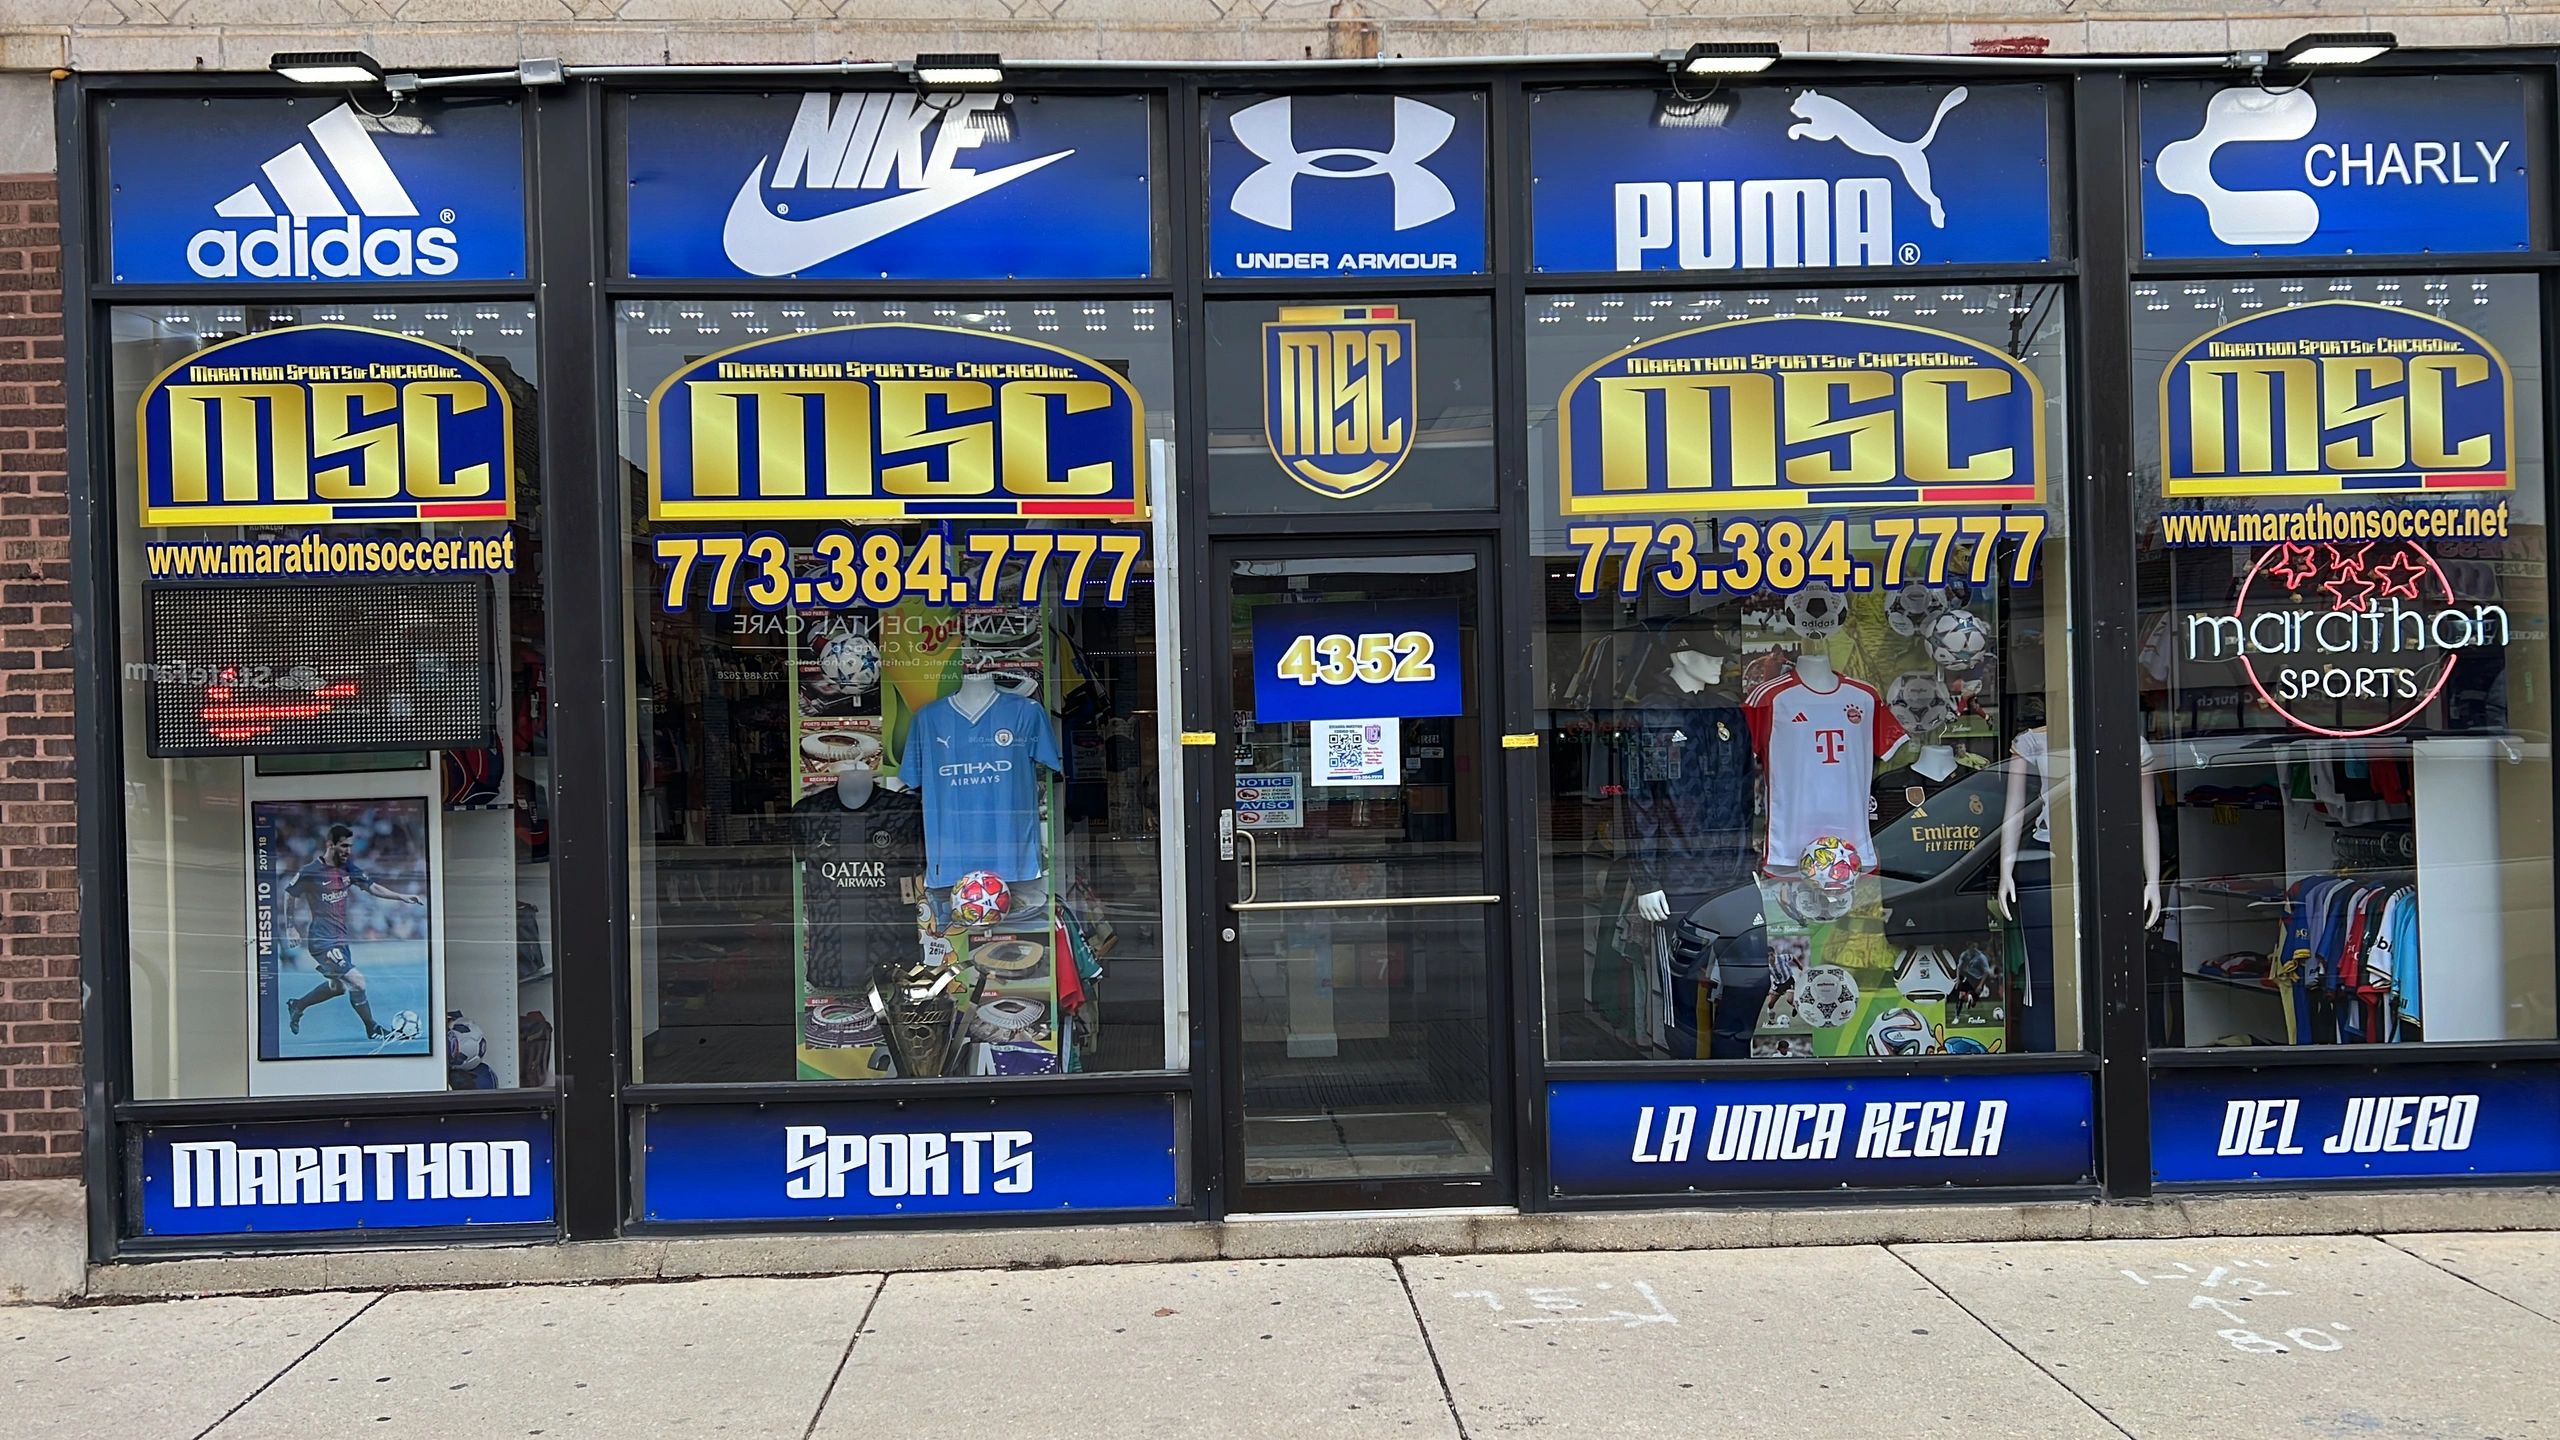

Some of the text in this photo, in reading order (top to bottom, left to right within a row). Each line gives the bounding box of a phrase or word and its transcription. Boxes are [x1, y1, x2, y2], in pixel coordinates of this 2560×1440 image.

[770, 92, 1000, 190] NIKE
[2304, 141, 2511, 188] CHARLY
[186, 215, 459, 278] adidas
[1615, 177, 1894, 272] PUMA
[1236, 252, 1457, 270] UNDER ARMOUR
[718, 361, 843, 379] MARATHON
[846, 360, 935, 378] SPORTS
[956, 361, 1049, 378] CHICAGO
[1627, 356, 1747, 374] MARATHON
[1751, 353, 1839, 370] SPORTS
[1858, 352, 1949, 368] CHICAGO
[2208, 341, 2297, 358] MARATHON
[2299, 338, 2362, 355] SPORTS
[2377, 337, 2444, 353] CHICAGO
[189, 365, 284, 382] MARATHON
[287, 363, 352, 380] SPORTS
[369, 362, 439, 380] CHICAGO
[1278, 329, 1402, 456] MSC
[1594, 368, 2014, 492] MSC
[2185, 353, 2492, 474] MSC
[164, 381, 490, 502] MSC
[685, 380, 1113, 497] MSC
[2161, 502, 2509, 544] www.marathonsoccer.net
[147, 531, 514, 575] www.marathonsoccer.net
[655, 532, 1143, 609] 773.384.7777
[1568, 515, 2046, 595] 773.384.7777
[1801, 620, 1836, 628] adidas
[2188, 597, 2511, 659] marathon
[1277, 631, 1436, 686] 4352
[2279, 667, 2418, 700] SPORTS
[938, 760, 1012, 777] ETIHAD
[950, 775, 1001, 787] AIRWAYS
[1236, 778, 1292, 787] NOTICE
[1240, 801, 1290, 810] AVISO
[259, 836, 267, 846] 18
[259, 849, 268, 871] 2017
[1925, 841, 1941, 853] FLY
[257, 881, 271, 902] 10
[821, 861, 885, 881] QATAR
[836, 877, 886, 888] AIRWAYS
[258, 905, 273, 956] MESSI
[1631, 1100, 2008, 1163] LA UNICA REGLA
[2217, 1094, 2480, 1157] DEL JUEGO
[170, 1140, 531, 1208] MARATHON
[784, 1125, 1033, 1199] SPORTS
